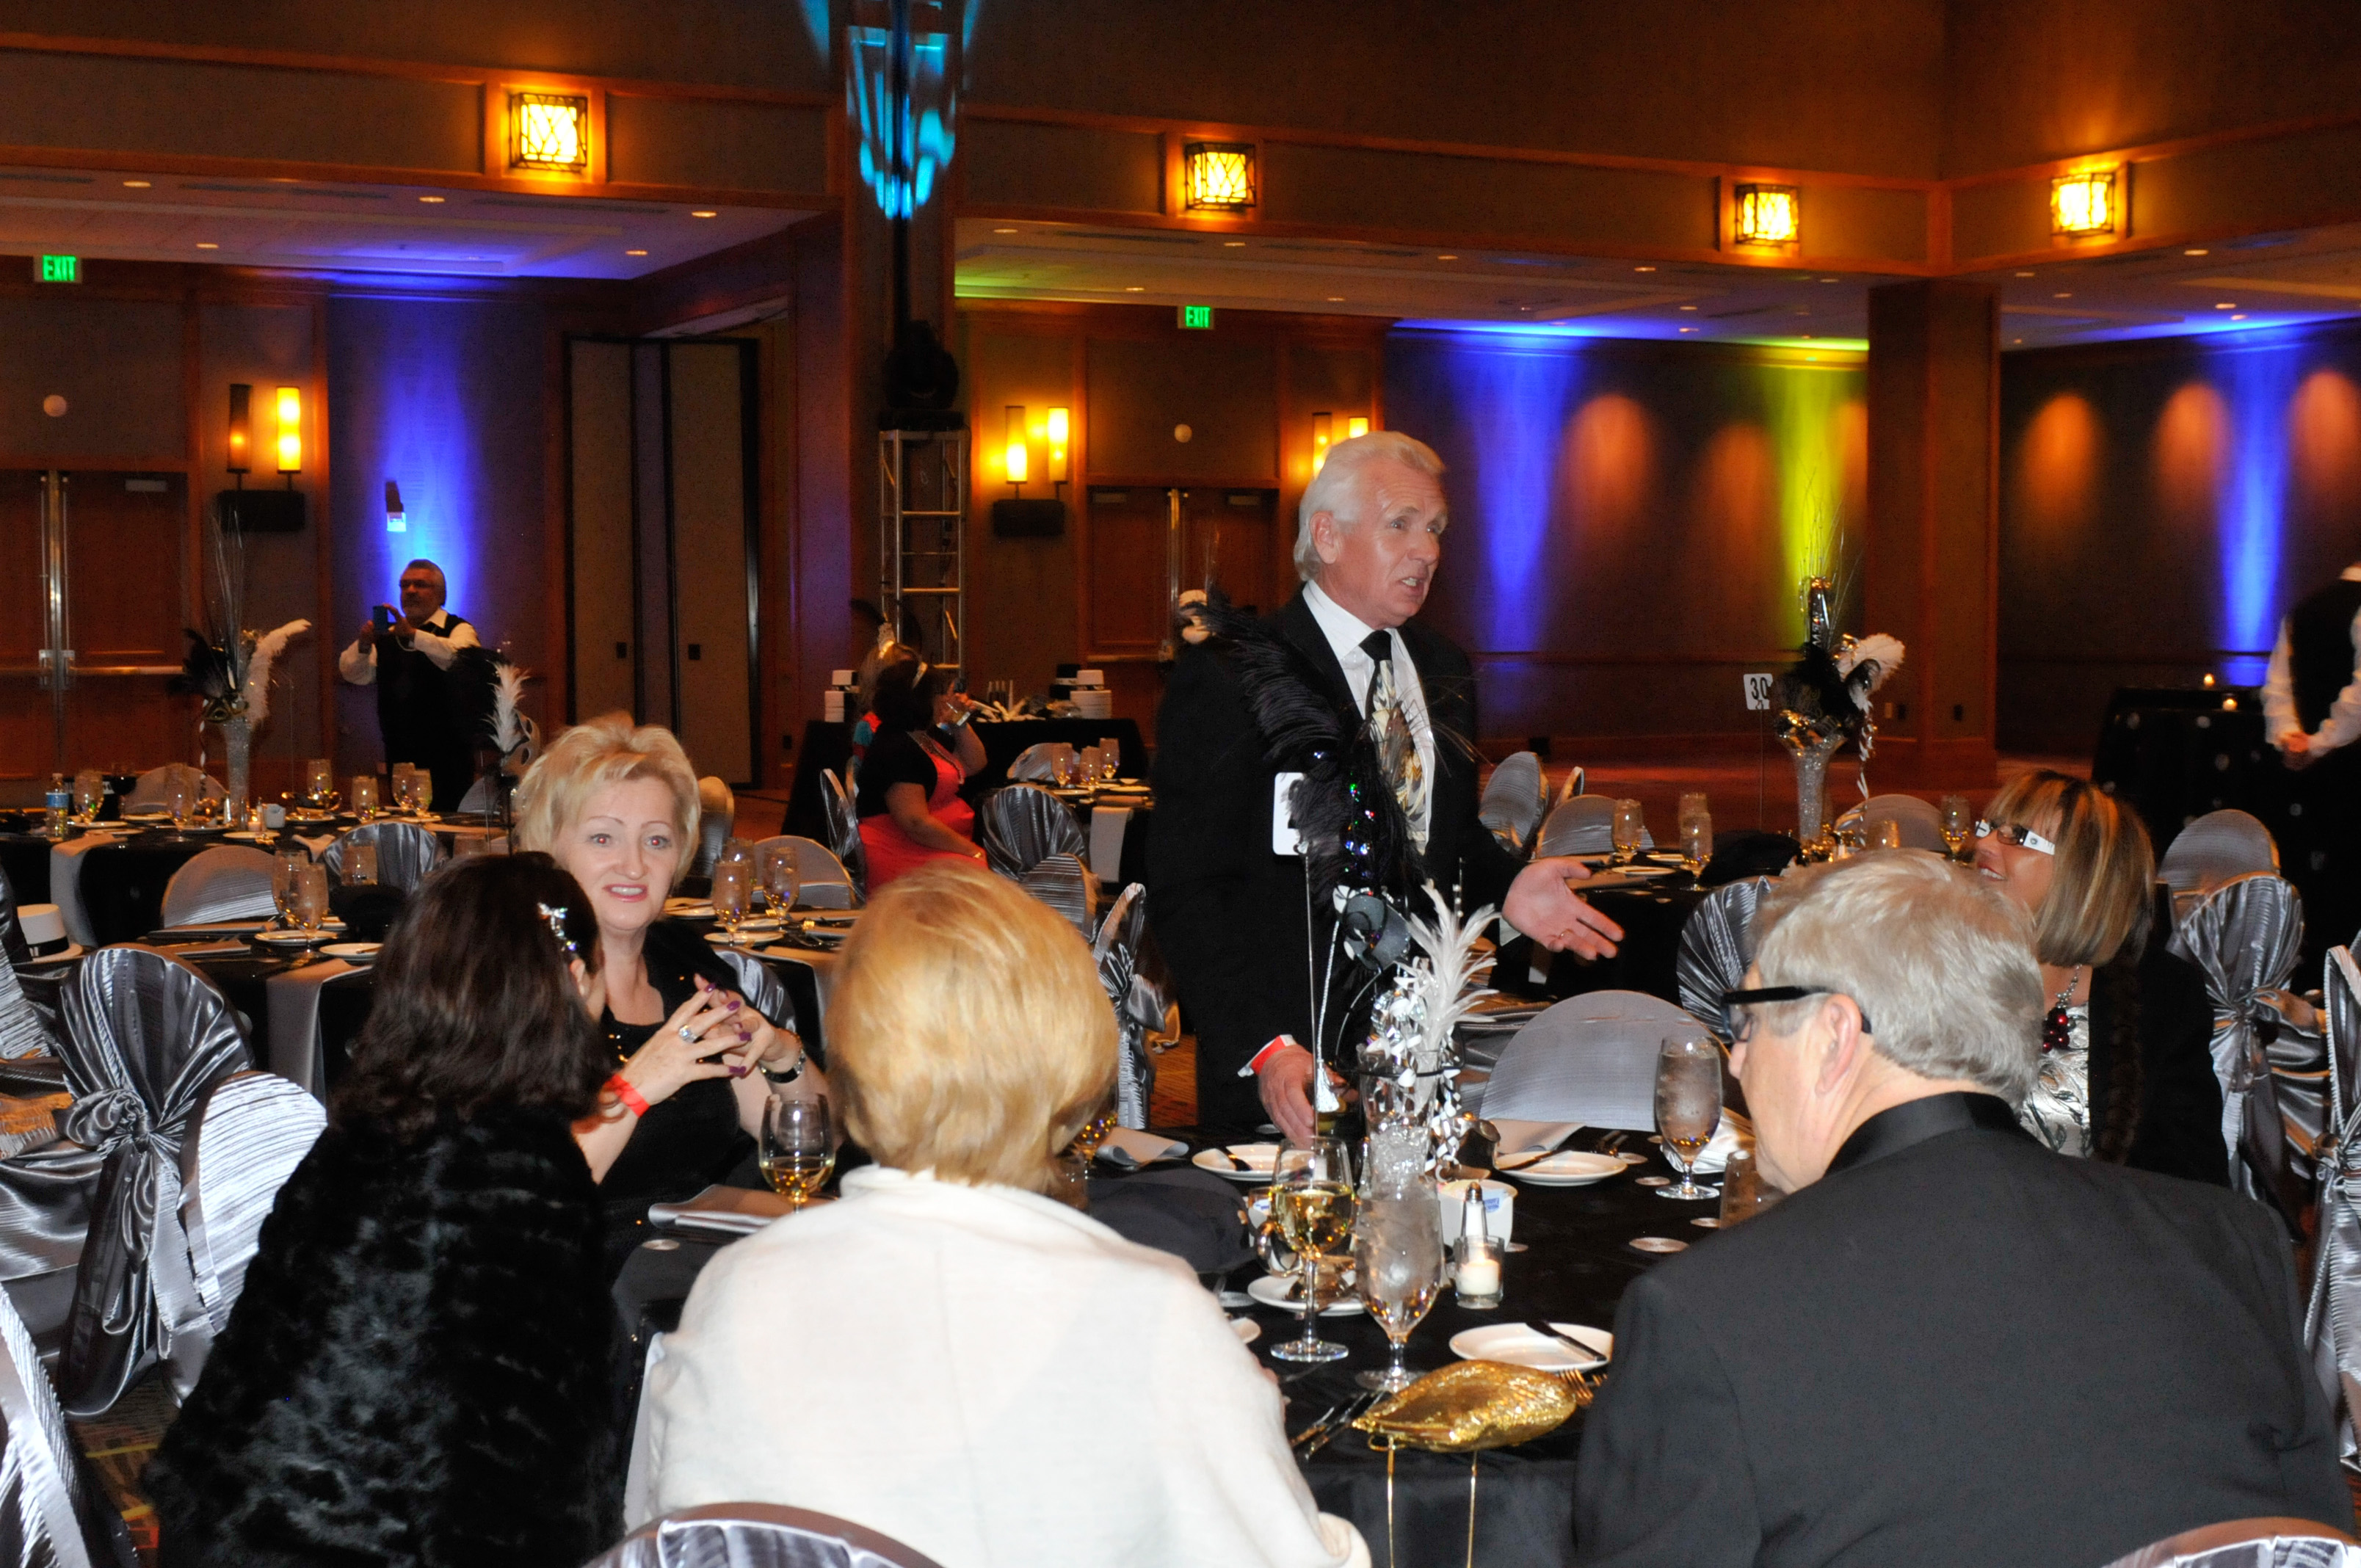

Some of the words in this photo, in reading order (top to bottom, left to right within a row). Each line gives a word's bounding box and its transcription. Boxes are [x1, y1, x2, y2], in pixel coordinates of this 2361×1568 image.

[43, 254, 76, 282] EXIT
[1186, 306, 1211, 328] EXIT
[1750, 677, 1769, 700] 30
